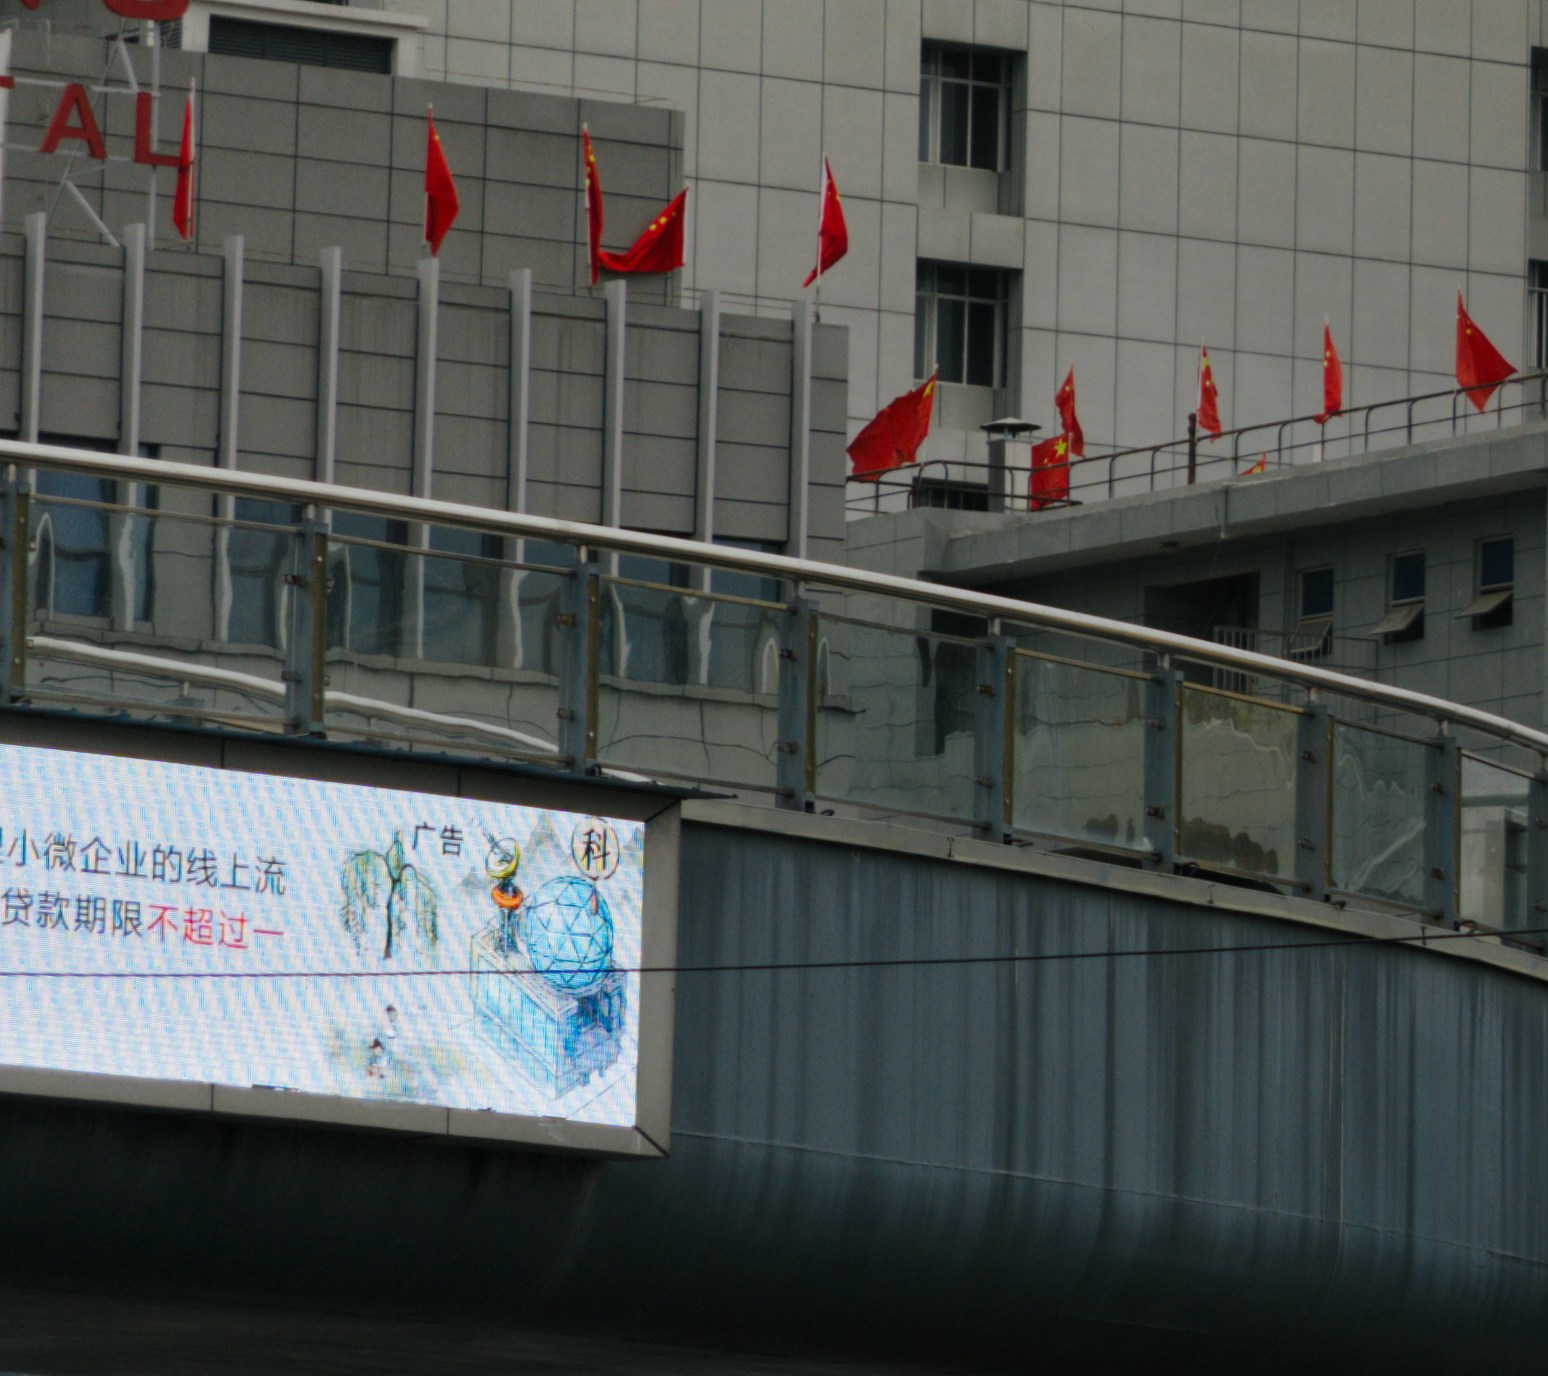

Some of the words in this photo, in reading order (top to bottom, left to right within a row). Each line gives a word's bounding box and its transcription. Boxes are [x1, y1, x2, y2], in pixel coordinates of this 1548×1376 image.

[0, 76, 184, 167] AL
[0, 827, 287, 896] 小微企业的线上流
[412, 821, 464, 857] 广告
[581, 828, 610, 872] 科
[1, 887, 285, 950] 贷款期限不超过一
